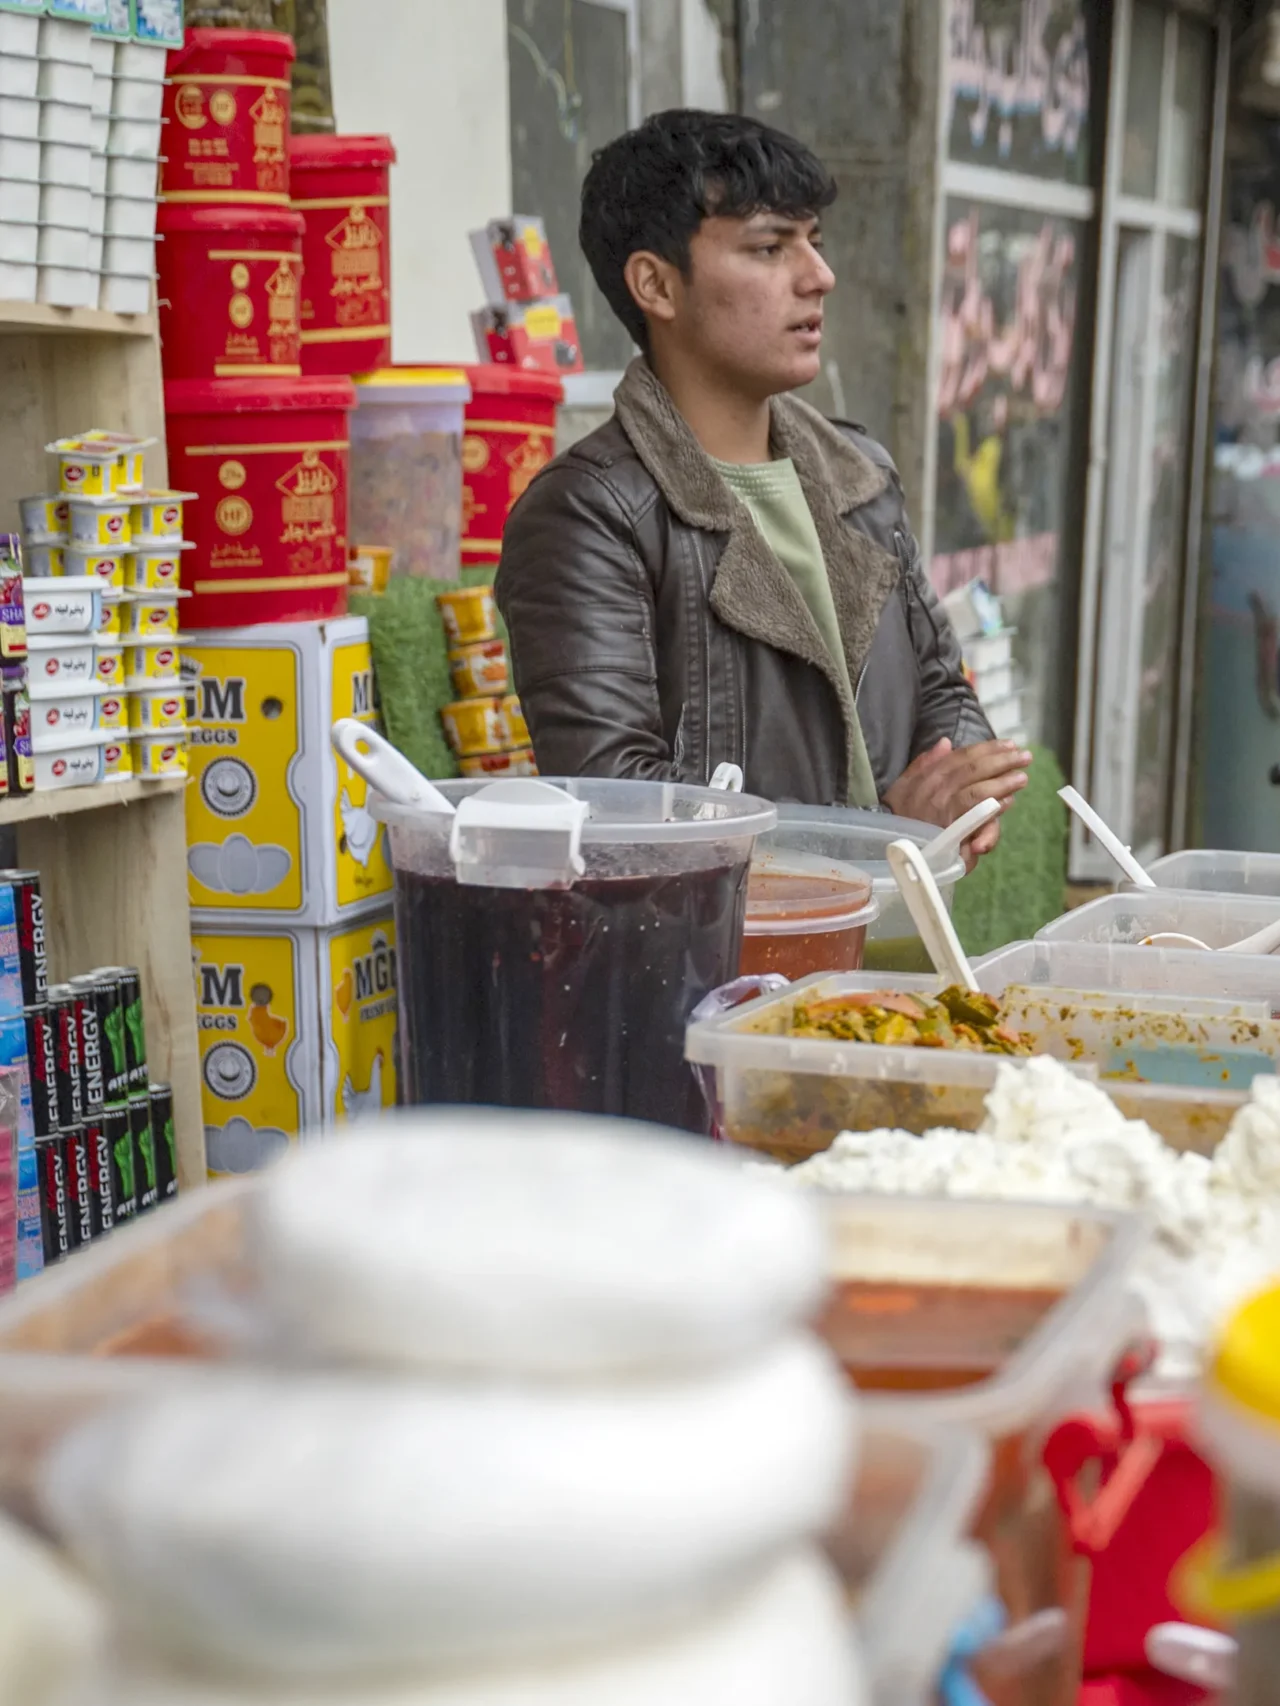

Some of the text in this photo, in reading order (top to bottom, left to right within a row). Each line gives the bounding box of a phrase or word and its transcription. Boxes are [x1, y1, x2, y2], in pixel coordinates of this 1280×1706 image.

[31, 893, 48, 991] ENERGY
[42, 1024, 58, 1121] ENERGY
[67, 1016, 82, 1112] ENERGY
[81, 1009, 104, 1105] ENERGY
[96, 1136, 113, 1229] ENERGY
